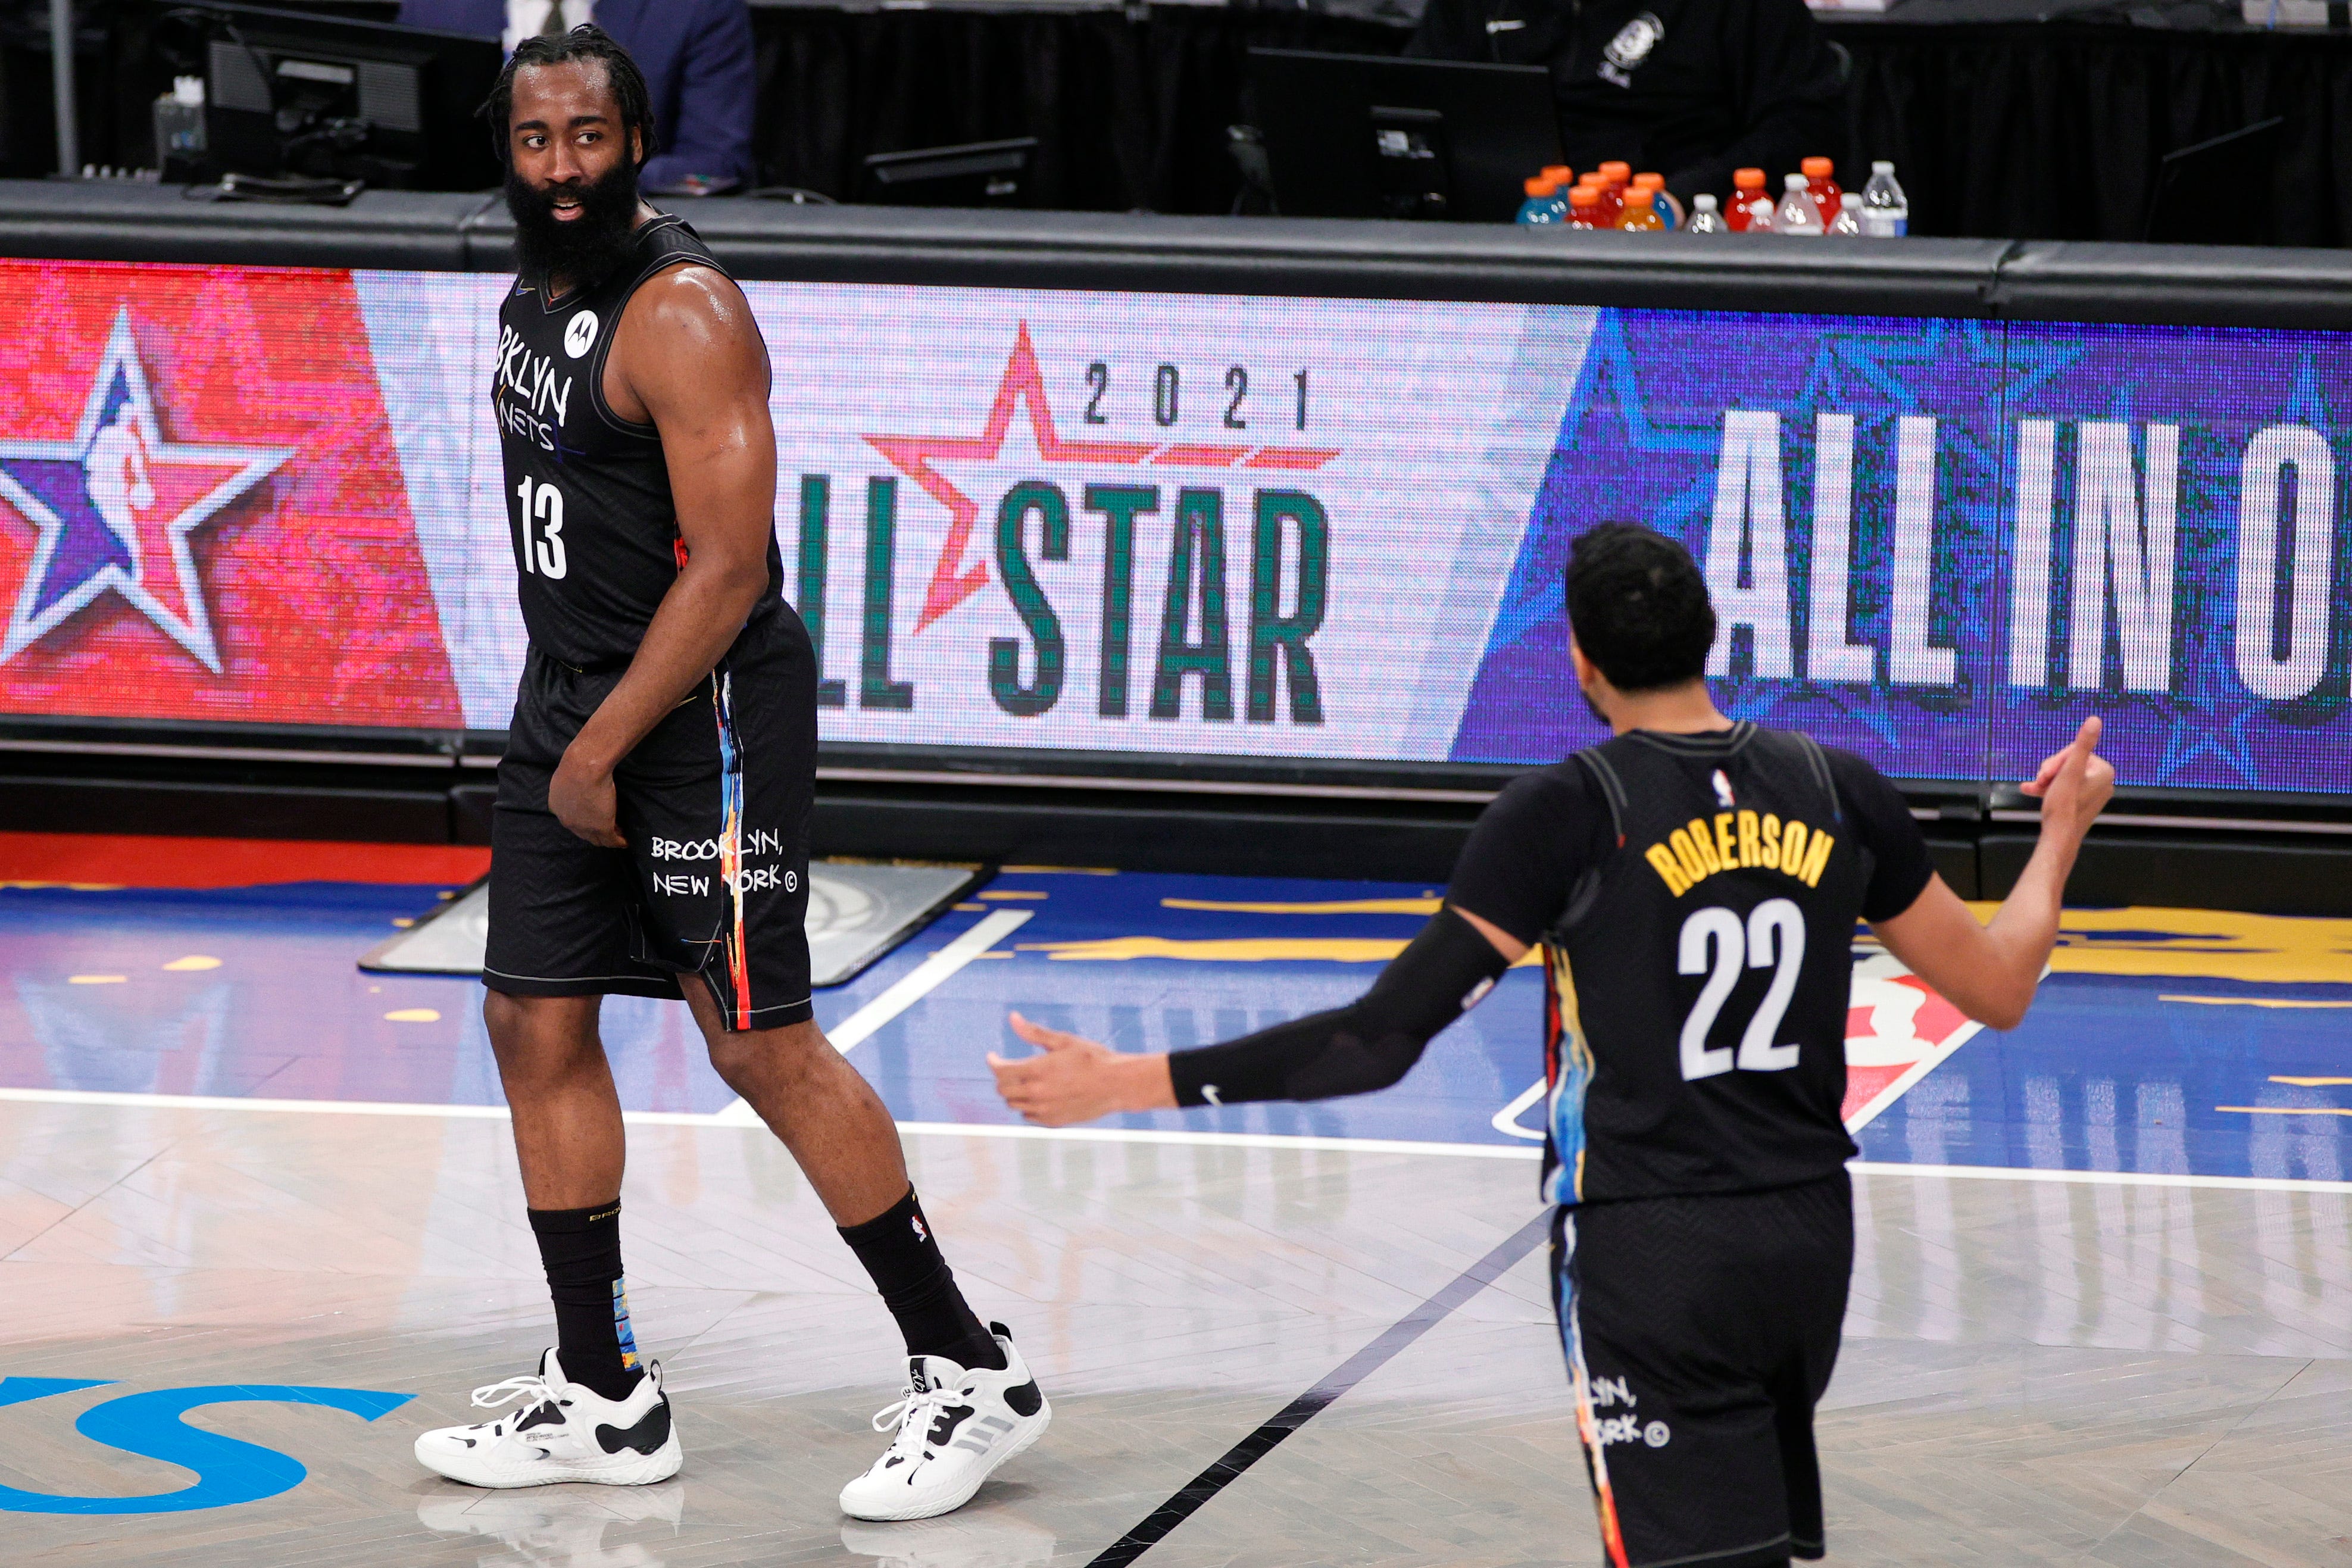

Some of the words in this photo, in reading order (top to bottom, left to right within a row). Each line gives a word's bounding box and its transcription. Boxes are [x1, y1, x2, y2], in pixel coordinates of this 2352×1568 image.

[495, 324, 572, 427] BKLYN
[499, 398, 554, 451] NETS
[1085, 363, 1307, 430] 2021
[517, 474, 567, 580] 13
[1706, 410, 1956, 686] ALL
[2008, 418, 2180, 693] IN
[2235, 423, 2352, 701] O
[797, 474, 913, 709] LL
[989, 480, 1329, 725] STAR
[653, 872, 710, 897] NEW
[1644, 810, 1835, 898] ROBERSON
[1678, 897, 1806, 1082] 22
